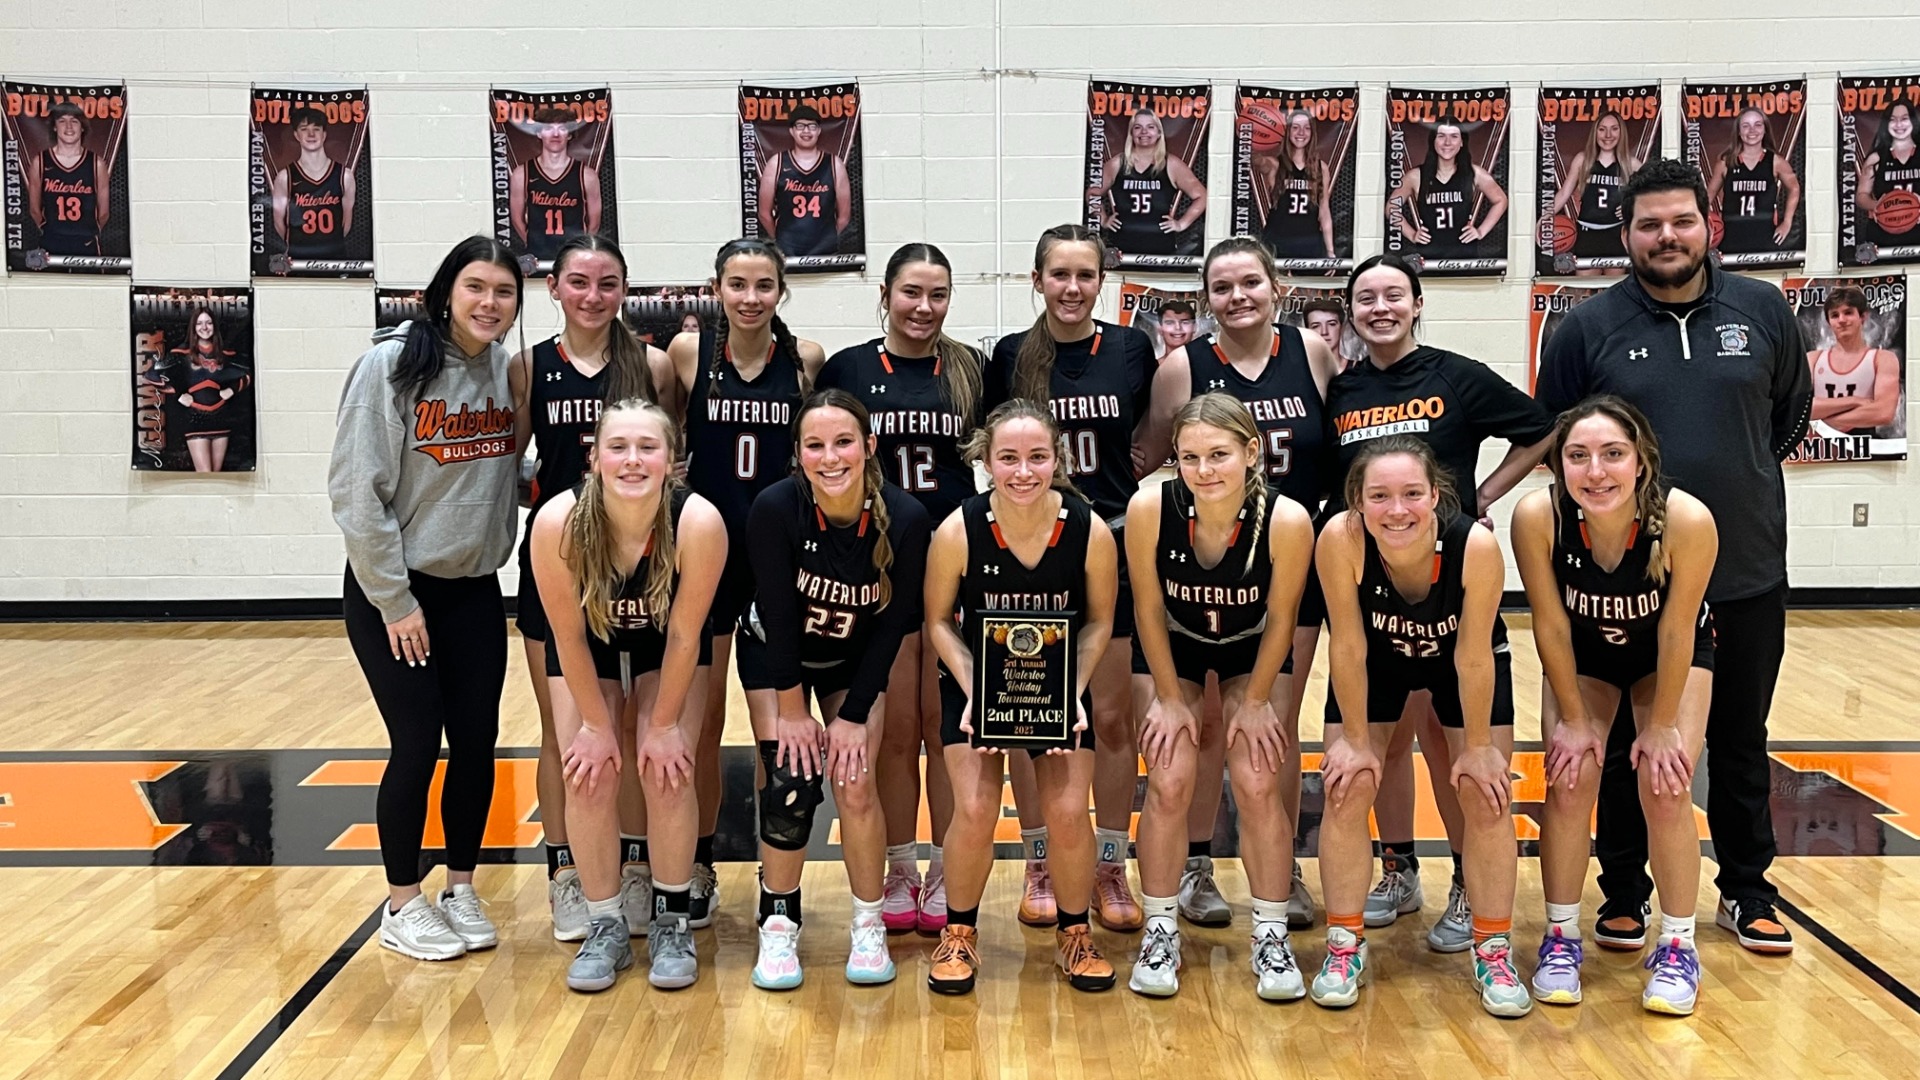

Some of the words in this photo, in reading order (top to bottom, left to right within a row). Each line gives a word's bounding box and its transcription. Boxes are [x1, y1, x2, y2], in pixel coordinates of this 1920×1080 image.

[17, 85, 111, 95] WATERLOO
[754, 86, 843, 97] WATERLOO
[1104, 84, 1196, 95] WATERLOO
[1251, 89, 1344, 99] WATERLOO
[1554, 88, 1647, 97] WATERLOO
[1696, 83, 1791, 94] WATERLOO
[1854, 78, 1920, 87] WATER
[7, 93, 123, 119] BULOGS
[263, 92, 352, 101] WATERLOO
[505, 92, 595, 102] WATERLOO
[1402, 91, 1495, 100] WATERLOO
[254, 99, 365, 124] BULOGS
[496, 99, 608, 124] BULOGS
[1686, 122, 1700, 168] ERSON
[1842, 115, 1856, 163] DAVIS
[251, 131, 265, 195] YOCHUM
[494, 132, 509, 199] LOHMAN
[1089, 118, 1105, 189] MELCHING
[1237, 123, 1252, 199] NOTTMEIER
[1390, 131, 1404, 189] COLSON
[1542, 125, 1556, 183] KANYUCK
[6, 140, 21, 215] SCHWEHR
[1123, 180, 1161, 190] WATERLOO
[1587, 174, 1623, 186] ATERLO
[1732, 180, 1767, 191] WATERLOO
[1884, 169, 1920, 182] WATERLO
[56, 195, 81, 221] 13
[792, 195, 821, 218] 34
[1130, 194, 1152, 213] 35
[1288, 193, 1309, 214] 32
[1597, 188, 1608, 208] 2
[1740, 195, 1756, 217] 14
[1842, 171, 1856, 247] KATELYN
[252, 203, 265, 254] CALEB
[302, 208, 334, 234] 30
[497, 207, 511, 248] SAAC
[545, 209, 564, 235] 11
[1389, 197, 1402, 251] OLIVIA
[1436, 207, 1454, 229] 21
[1541, 190, 1555, 257] ANGELYNN
[8, 223, 22, 250] ELI
[1134, 255, 1158, 265] Class
[1283, 259, 1307, 268] Class
[1437, 260, 1461, 269] Class
[1736, 254, 1760, 263] Class
[1785, 284, 1904, 307] BULOGS
[136, 330, 166, 451] GOWER
[415, 397, 514, 441] Waterloo
[547, 399, 603, 425] WATER
[707, 398, 790, 425] WATERLOO
[1048, 395, 1120, 420] ATERLOO
[1243, 396, 1307, 421] TERLOO
[1334, 396, 1445, 437] WATERLOO
[870, 411, 962, 437] WATERLOO
[1342, 420, 1427, 444] BASKETBALL
[443, 441, 506, 459] BULLDOGS
[1059, 430, 1098, 475] 10
[896, 445, 937, 491] 12
[796, 568, 880, 606] WATERLOO
[1166, 579, 1259, 605] WATERLOO
[984, 590, 1069, 611] WATERLOO
[1566, 584, 1660, 620] WATERLOO
[805, 606, 856, 639] 23
[1206, 610, 1219, 633] 1
[1372, 611, 1458, 638] WATERLOO
[1600, 626, 1628, 645] 2
[1003, 668, 1046, 680] Waterloo
[1004, 659, 1017, 668] 3rd
[997, 692, 1052, 705] Tournament
[1006, 681, 1042, 695] Holiday
[987, 708, 1014, 722] 2nd
[1019, 709, 1063, 723] PLACE
